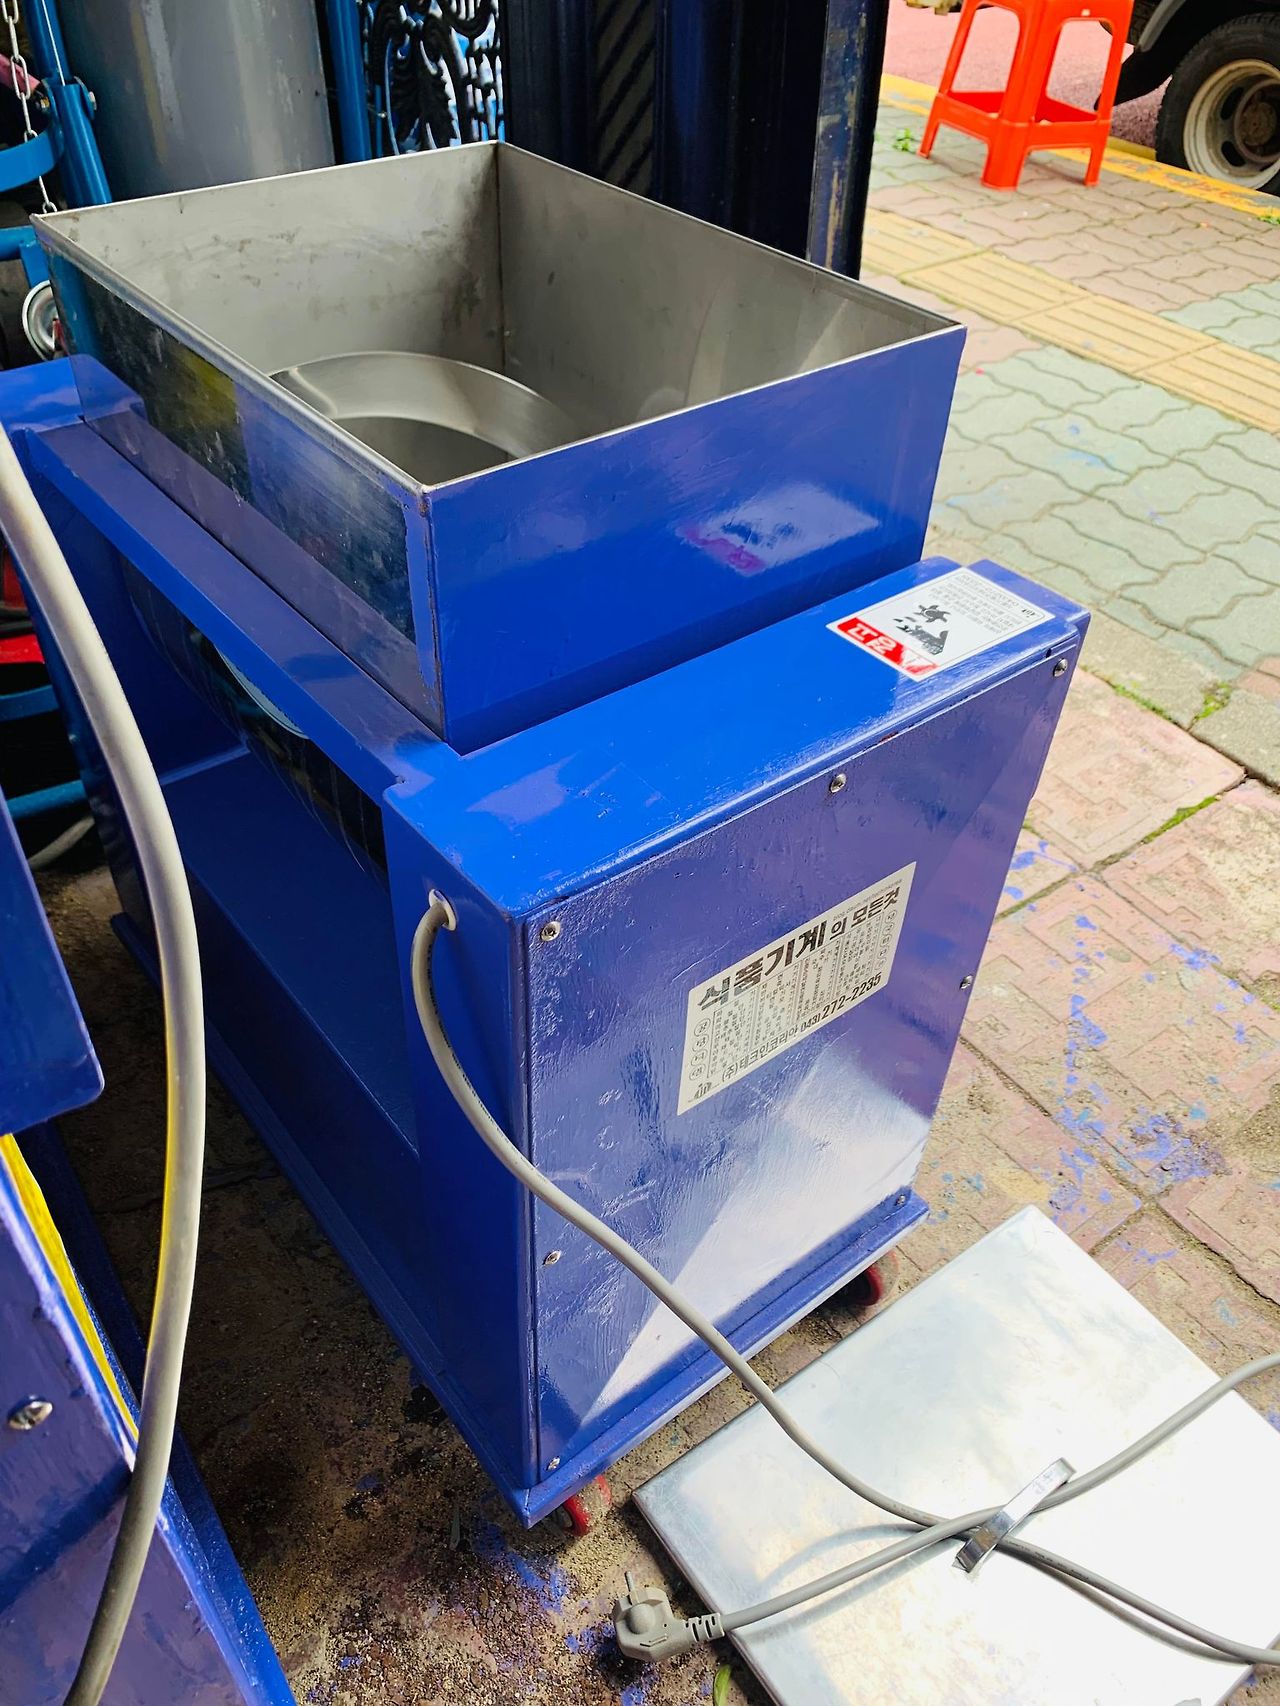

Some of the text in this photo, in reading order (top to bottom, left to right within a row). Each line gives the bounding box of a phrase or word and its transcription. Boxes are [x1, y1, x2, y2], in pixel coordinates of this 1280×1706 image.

[847, 623, 897, 656] 경고
[697, 919, 828, 1011] 식품기계
[829, 917, 848, 941] 의
[850, 886, 900, 929] 모든것
